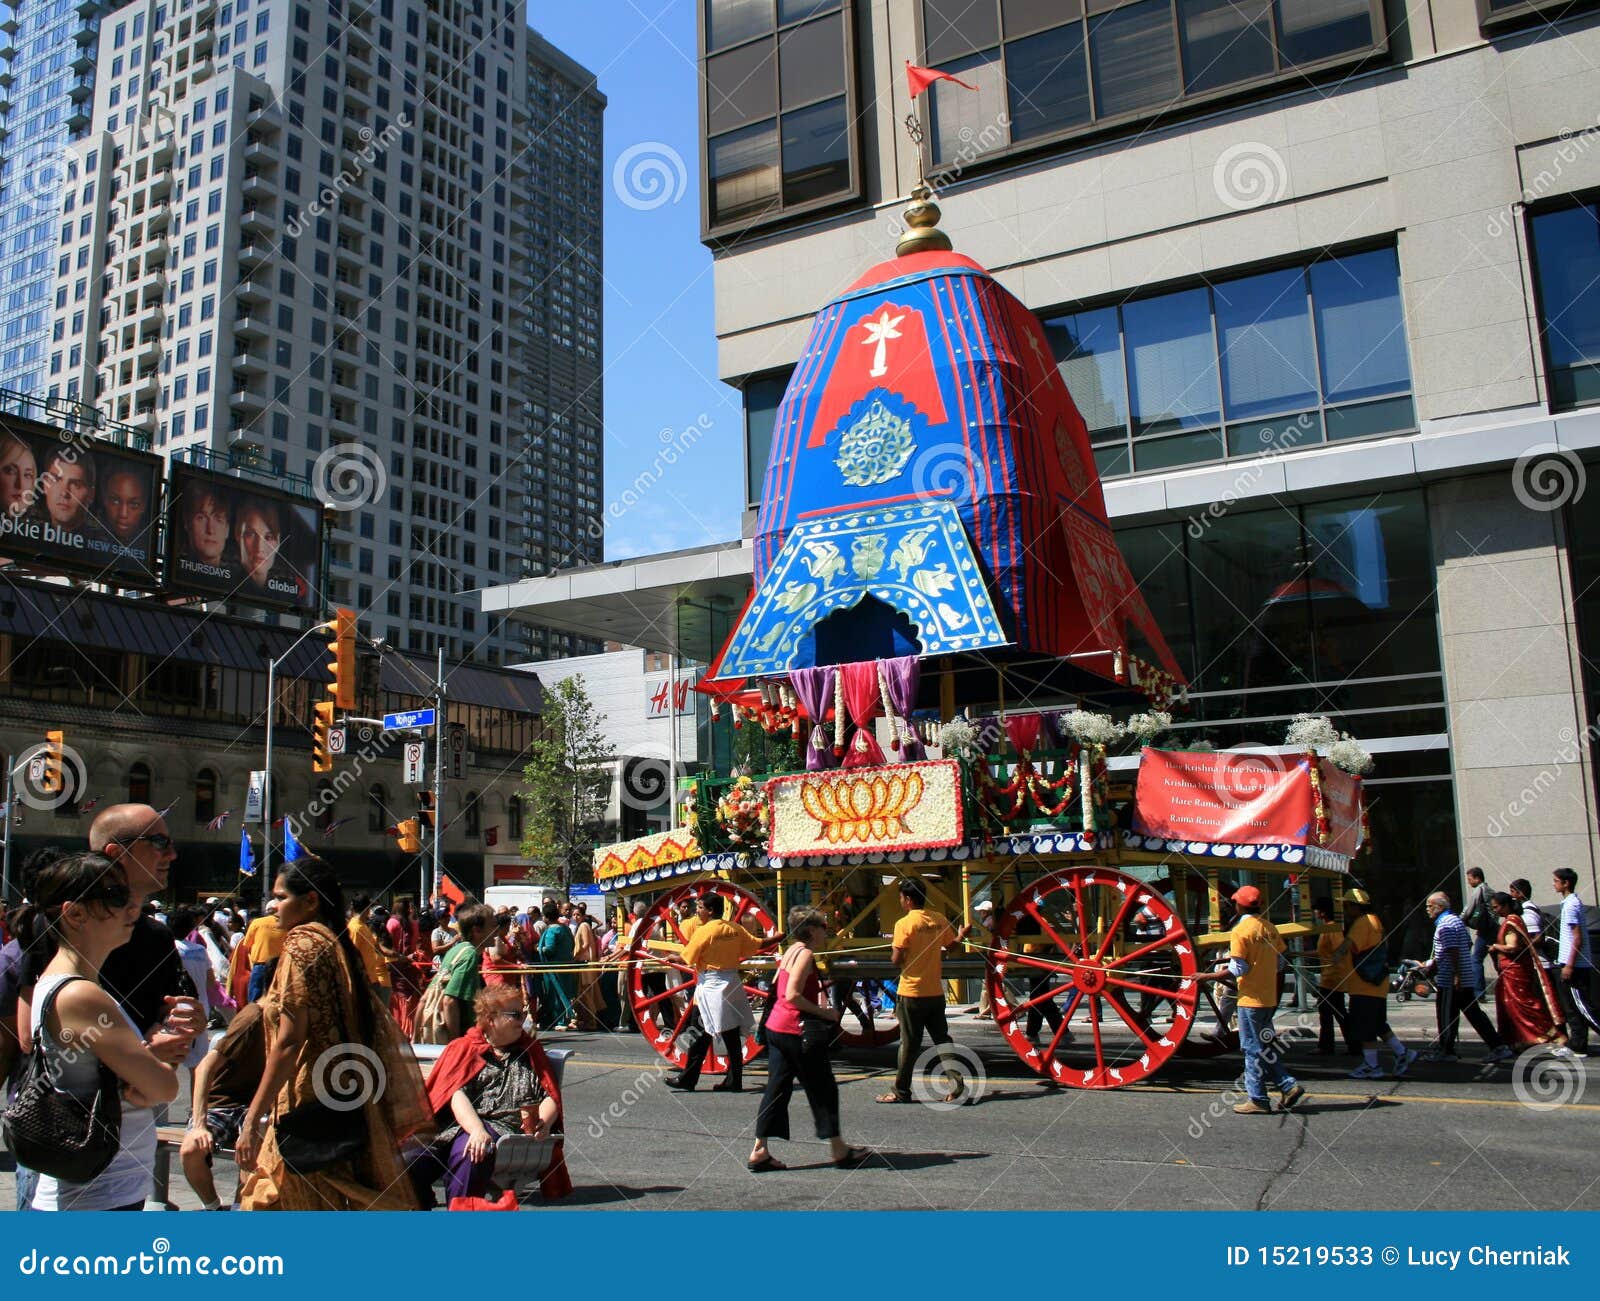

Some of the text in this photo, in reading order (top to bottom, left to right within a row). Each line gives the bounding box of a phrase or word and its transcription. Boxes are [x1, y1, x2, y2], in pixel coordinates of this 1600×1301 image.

[43, 521, 84, 548] blue
[87, 539, 111, 553] NEW
[180, 559, 231, 580] THURSDAYS
[267, 578, 299, 595] Global
[650, 678, 690, 714] H&M
[394, 713, 417, 728] Yonge
